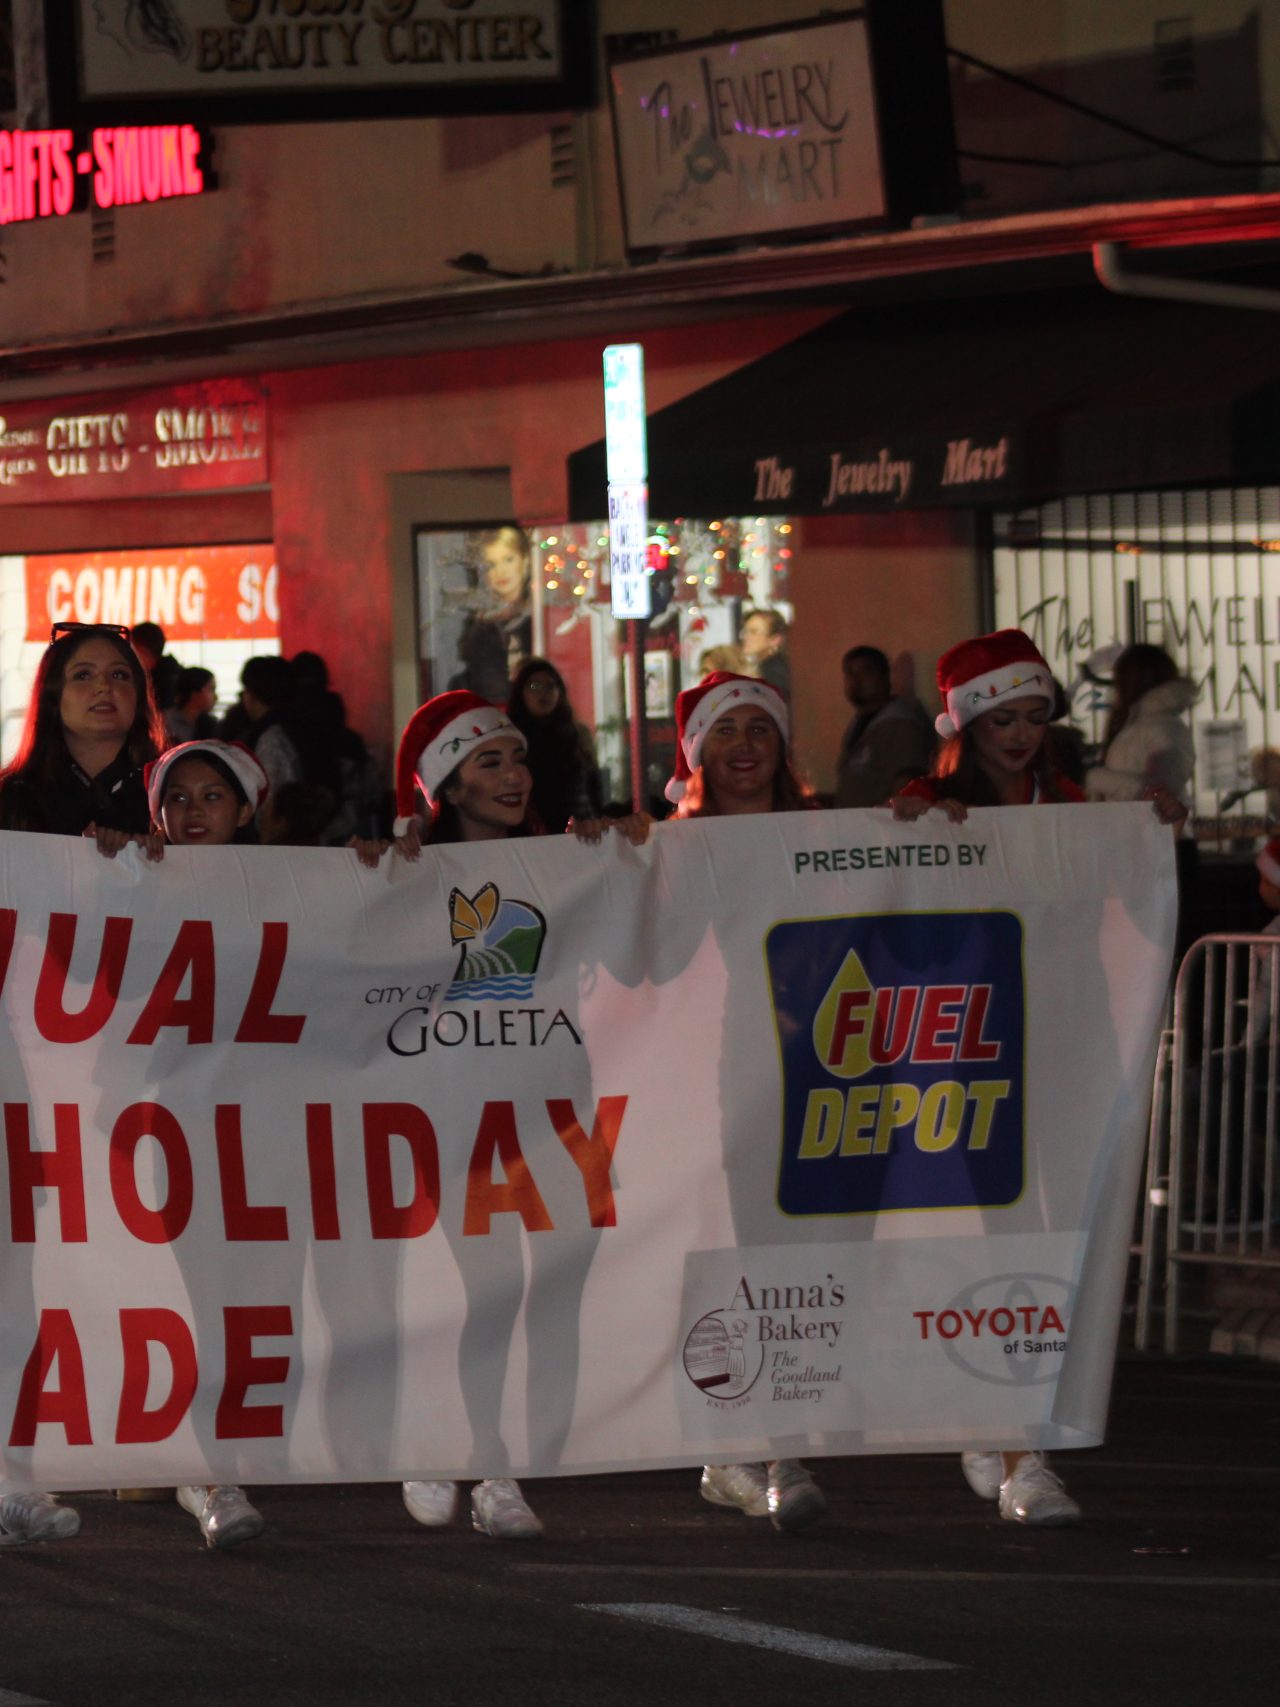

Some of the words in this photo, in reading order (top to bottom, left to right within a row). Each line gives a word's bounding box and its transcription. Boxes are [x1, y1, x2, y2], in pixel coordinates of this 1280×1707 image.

[196, 21, 364, 71] BEAUTY
[381, 15, 552, 64] CENTER
[46, 413, 131, 477] GIFTS
[753, 455, 795, 502] The
[824, 446, 915, 507] Jewelry
[940, 436, 1011, 487] Mart
[47, 566, 206, 626] COMING
[794, 844, 950, 874] PRESENTED
[957, 844, 987, 866] BY
[364, 987, 412, 1005] CITY
[415, 983, 441, 1001] OF
[386, 1007, 583, 1057] GOLETA
[825, 983, 1003, 1068] FUEL
[796, 1079, 1012, 1160] DEPOT
[7, 1093, 630, 1245] HOLIDAY
[730, 1274, 845, 1312] Anna's
[757, 1314, 844, 1348] Bakery
[913, 1305, 1067, 1341] TOYOTA
[771, 1351, 799, 1368] The
[1004, 1340, 1019, 1355] of
[1023, 1339, 1067, 1354] Santa
[770, 1365, 842, 1384] Goodland
[772, 1383, 825, 1403] Bakery
